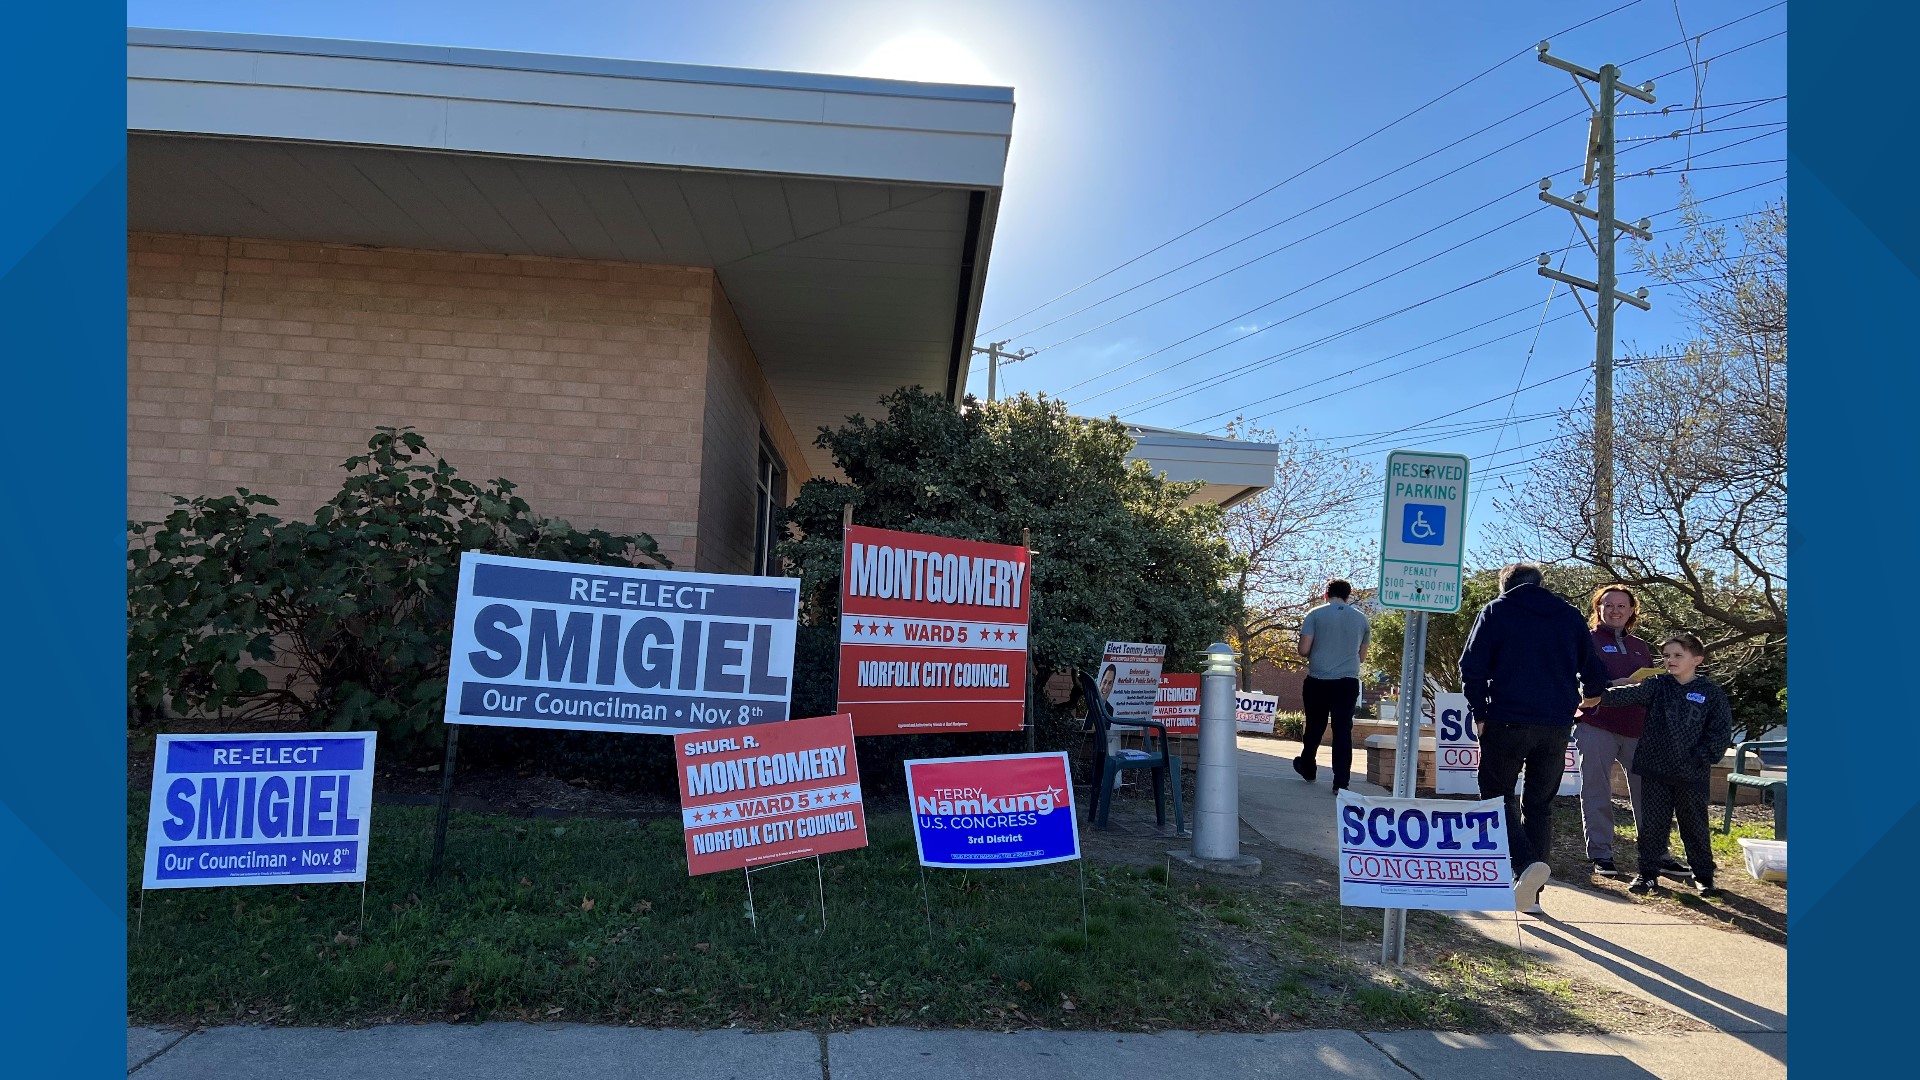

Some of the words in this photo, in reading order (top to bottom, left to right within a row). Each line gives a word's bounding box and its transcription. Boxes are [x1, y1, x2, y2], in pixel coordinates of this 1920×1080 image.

[1392, 462, 1463, 481] RESERVED
[1396, 483, 1456, 501] PARKING
[849, 543, 1026, 608] MONTGOMERY
[1403, 565, 1438, 578] PENALTY
[569, 577, 714, 609] RE-ELECT
[1438, 581, 1456, 592] FINE
[1434, 594, 1454, 605] ZONE
[904, 623, 954, 642] WARD
[957, 627, 968, 643] 5
[468, 603, 787, 696] SMIGIEL
[1107, 643, 1122, 654] Elect
[1123, 644, 1143, 656] Tommy
[1144, 645, 1165, 656] Smigiel
[858, 660, 921, 687] NORFOLK
[923, 662, 953, 687] CITY
[954, 663, 1010, 688] COUNCIL
[1156, 688, 1197, 702] NTGOMERY
[482, 689, 527, 712] Our
[535, 692, 667, 721] Councilman
[689, 703, 732, 725] Nov.
[1159, 707, 1177, 715] WARD
[1236, 698, 1275, 713] OTT
[213, 747, 323, 765] RE-ELECT
[684, 738, 740, 756] SHURL
[743, 736, 760, 748] R.
[686, 745, 846, 797] MONTGOMERY
[934, 787, 983, 800] TERRY
[162, 775, 359, 841] SMIGIEL
[736, 796, 794, 817] WARD
[798, 794, 810, 809] 5
[918, 793, 1054, 815] Namkung
[920, 817, 947, 830] U.S.
[951, 813, 1037, 829] CONGRESS
[1342, 805, 1500, 850] SCOTT
[692, 825, 761, 855] NORFOLK
[763, 820, 794, 843] CITY
[797, 810, 857, 838] COUNCIL
[968, 835, 984, 844] 3rd
[987, 834, 1023, 843] District
[165, 853, 194, 871] Our
[199, 851, 287, 870] Councilman
[301, 850, 330, 866] Nov.
[1348, 855, 1499, 882] CONGRESS
